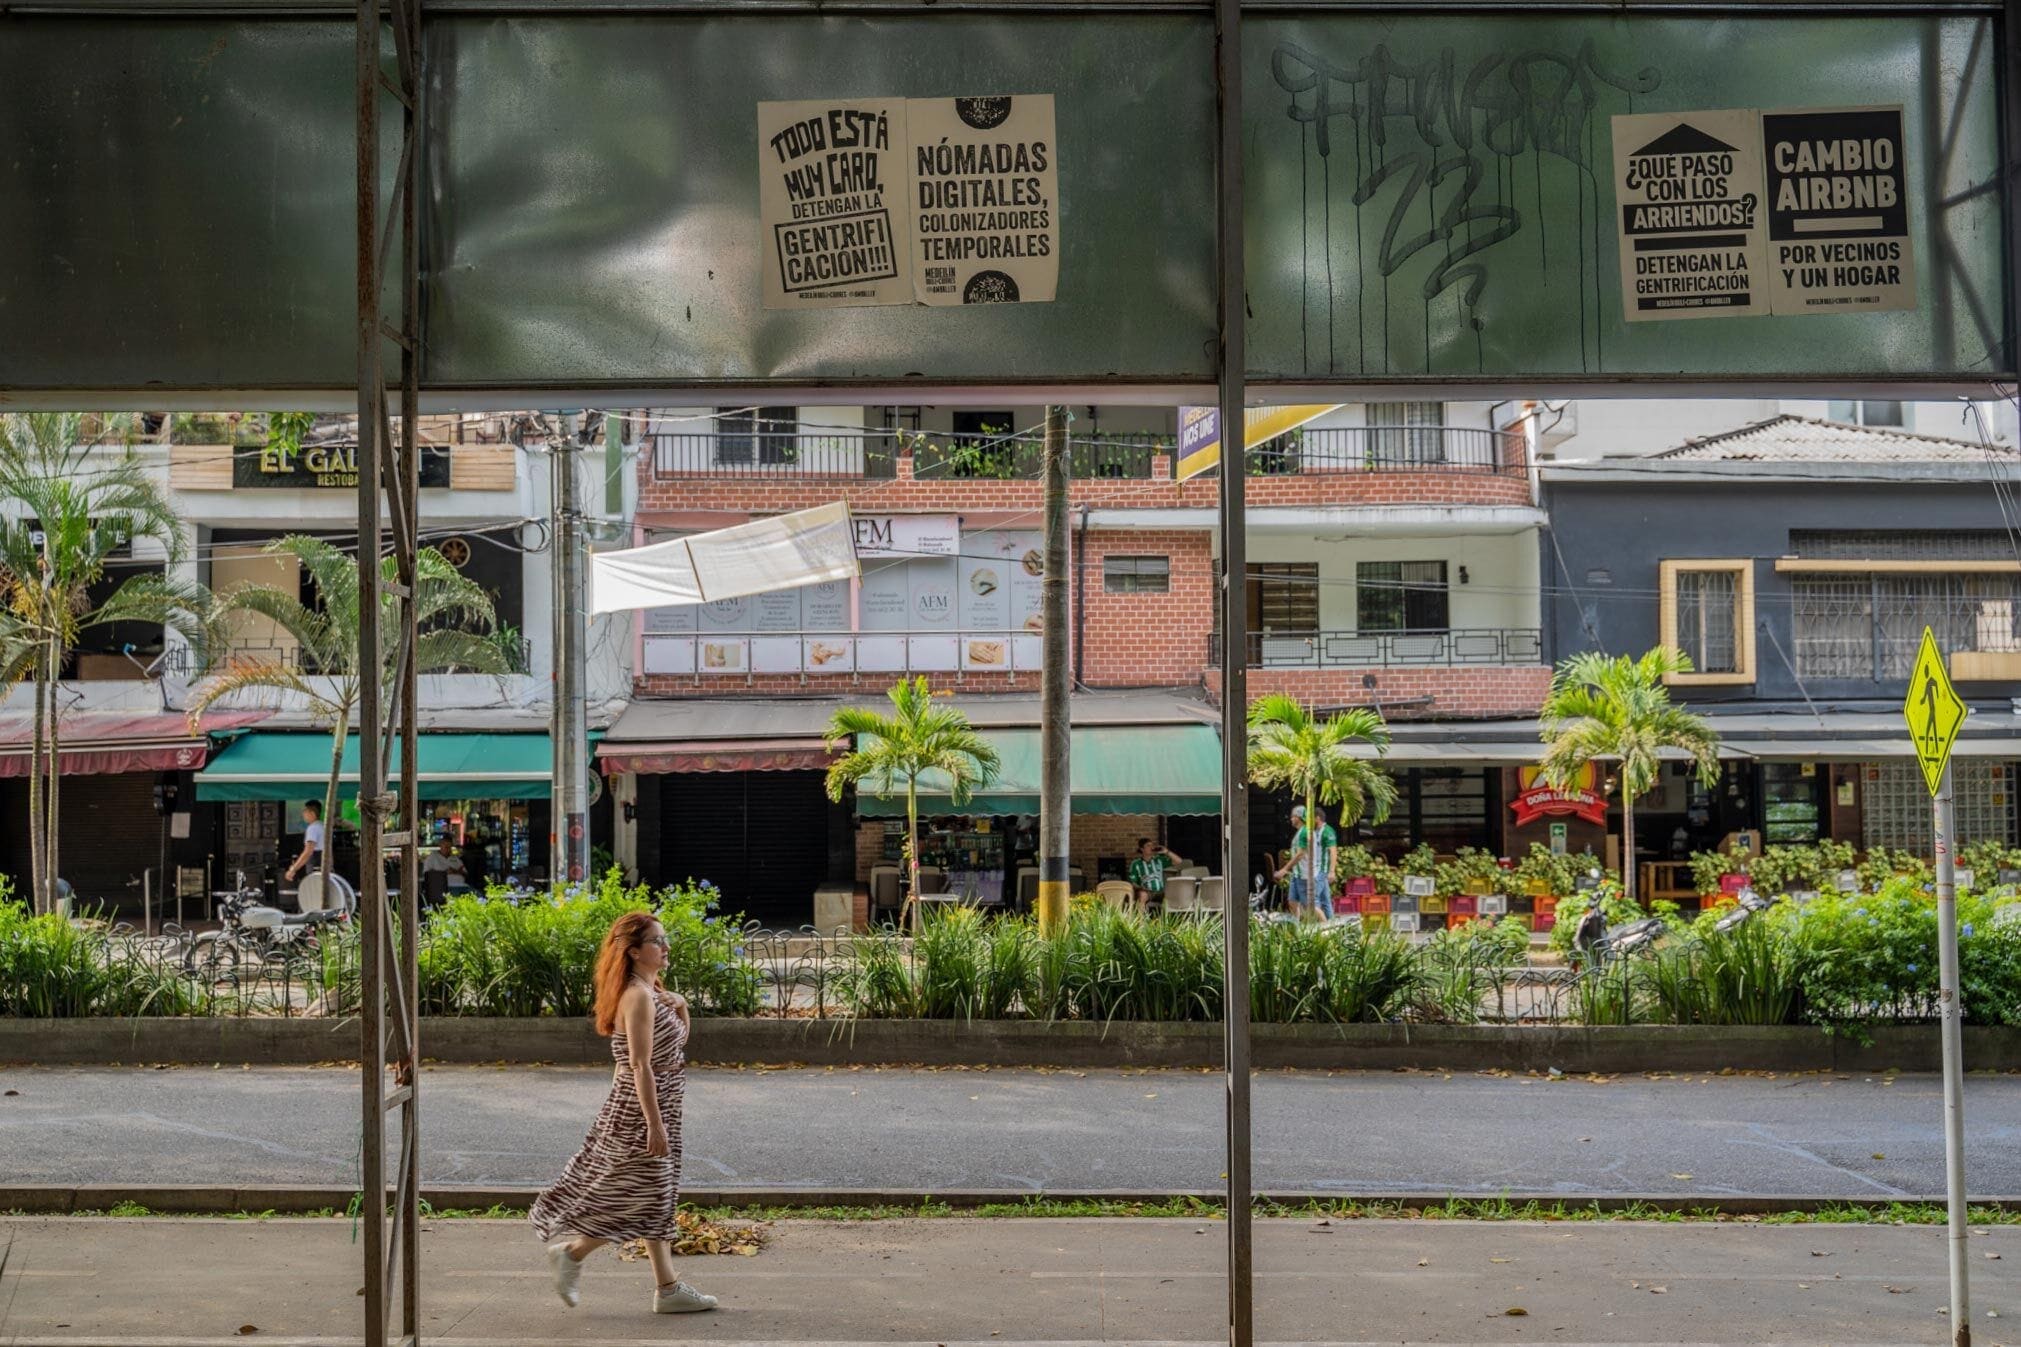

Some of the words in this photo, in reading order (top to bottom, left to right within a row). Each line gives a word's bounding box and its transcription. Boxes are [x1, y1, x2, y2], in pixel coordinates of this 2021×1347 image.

[770, 117, 827, 163] TODO
[827, 109, 889, 151] ESTÁ
[917, 136, 1048, 176] NÓMADAS
[1774, 137, 1894, 173] CAMBIO
[783, 162, 826, 201] MUY
[826, 151, 884, 195] CARO,
[1646, 179, 1687, 201] CON
[1691, 177, 1728, 199] LOS
[792, 197, 862, 219] DETENGAN
[864, 192, 883, 209] LA
[919, 177, 1048, 210] DIGITALES,
[1776, 175, 1897, 211] AIRBNB
[919, 210, 1050, 233] COLONIZADORES
[1633, 193, 1757, 229] ARRIENDOS?
[784, 218, 885, 256] GENTRIFI
[920, 234, 1051, 261] TEMPORALES
[1636, 253, 1722, 274] DETENGAN
[1726, 252, 1748, 270] LA
[1780, 245, 1817, 264] POR
[1821, 242, 1900, 262] VECINOS
[1636, 271, 1749, 294] GENTRIFICACIÓN
[1782, 269, 1795, 288] Y
[1800, 268, 1828, 287] UN
[1834, 265, 1901, 286] HOGAR
[1183, 423, 1199, 449] NOS
[260, 448, 295, 473] EL
[853, 518, 894, 544] FM
